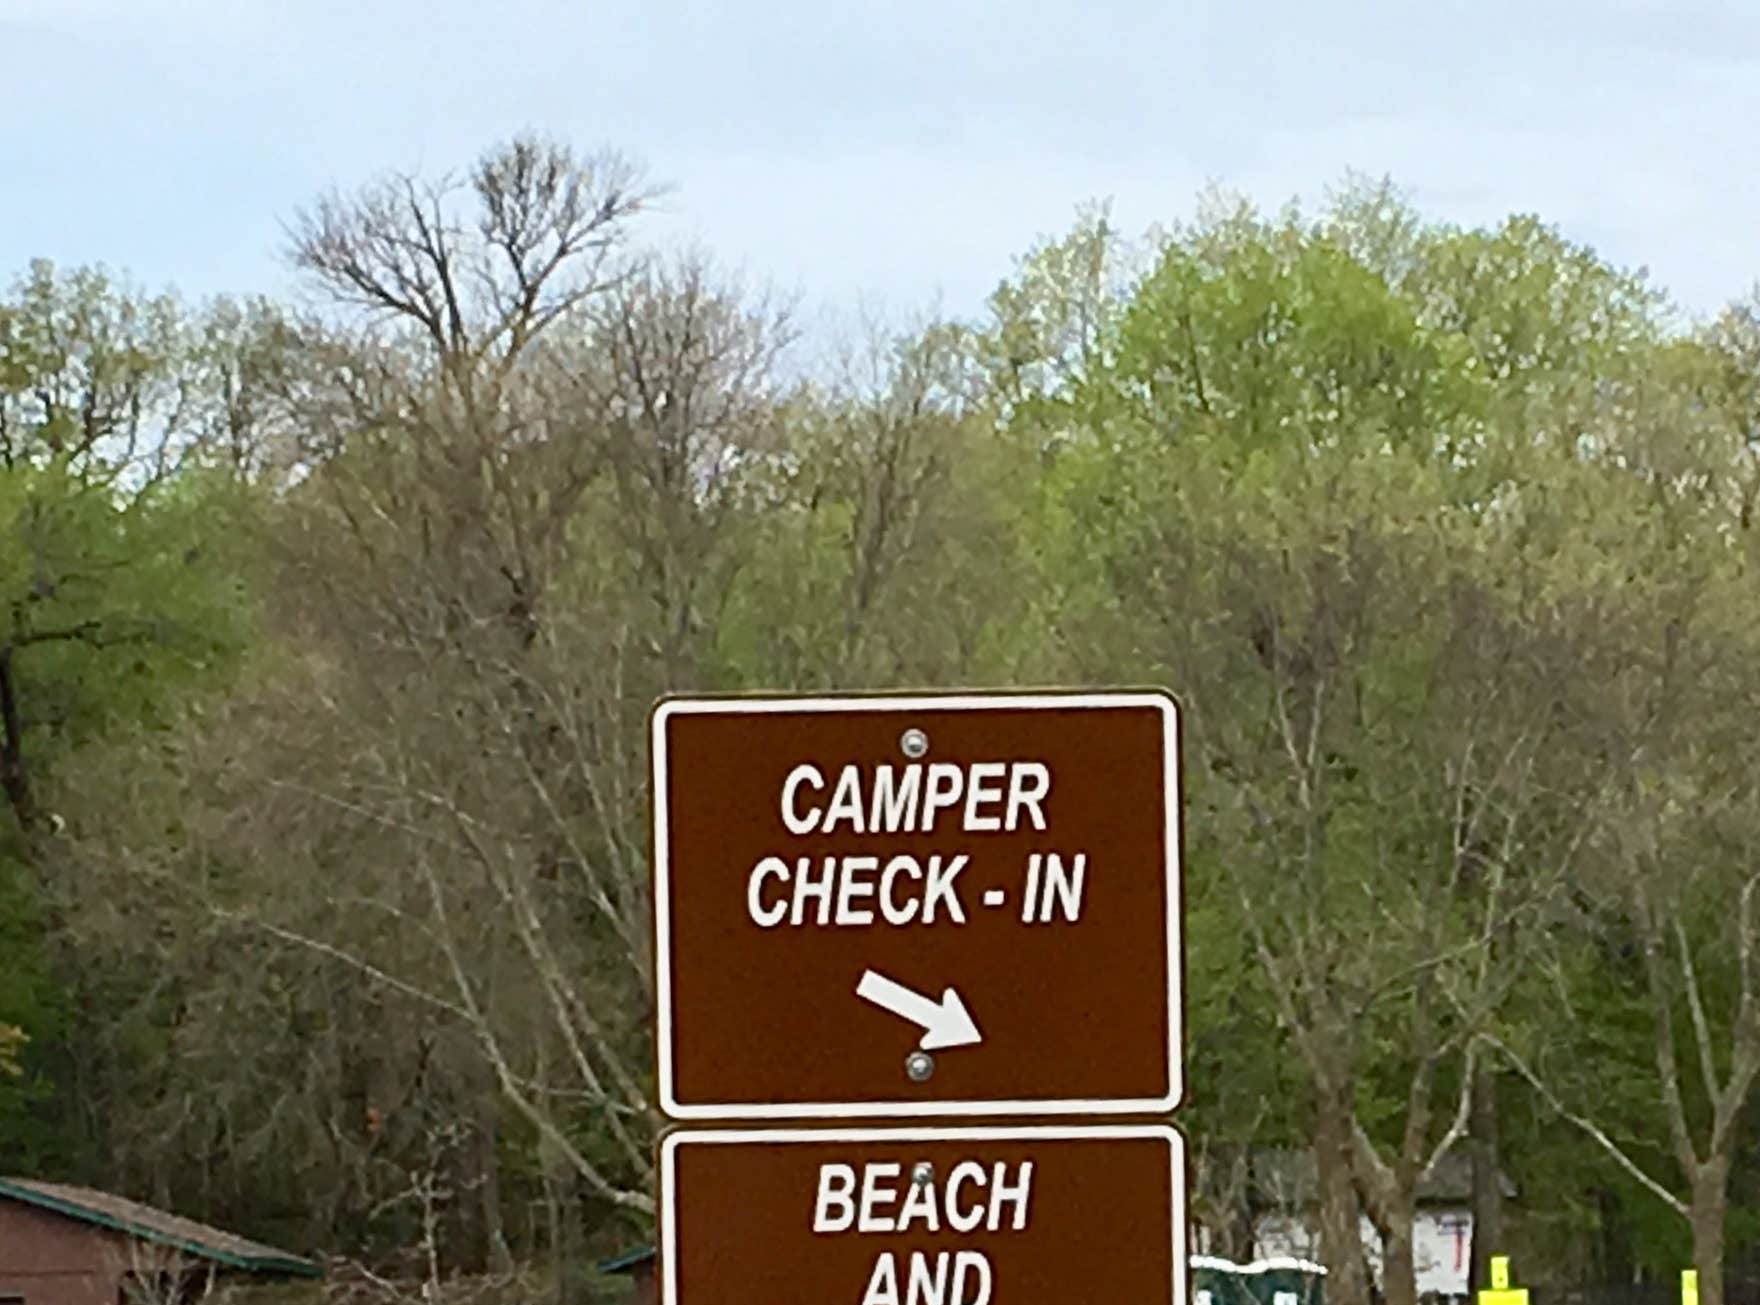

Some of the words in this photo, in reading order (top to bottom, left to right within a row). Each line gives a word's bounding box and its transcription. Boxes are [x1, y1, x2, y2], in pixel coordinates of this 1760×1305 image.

[781, 762, 1050, 834] CAMPER
[747, 855, 968, 927] CHECK
[1021, 854, 1086, 922] IN
[813, 1161, 1033, 1233] BEACH
